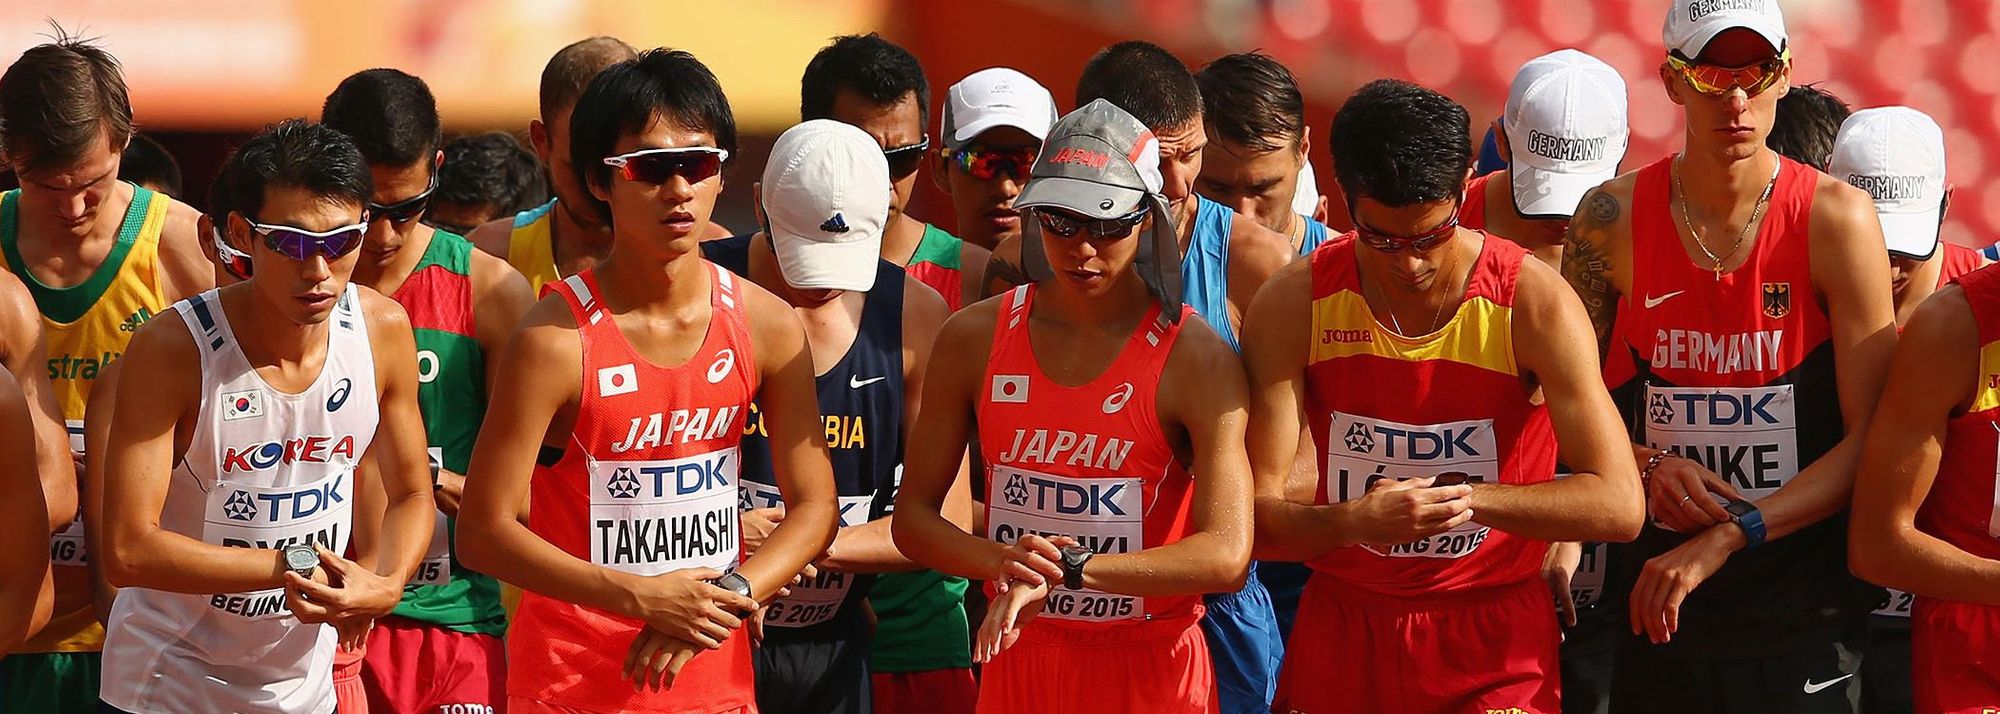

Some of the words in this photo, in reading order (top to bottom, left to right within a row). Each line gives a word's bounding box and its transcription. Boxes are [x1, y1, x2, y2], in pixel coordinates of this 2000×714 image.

[1050, 147, 1110, 168] JAPAN
[1528, 130, 1606, 161] GERMANY
[1848, 174, 1924, 199] GERMANY
[1652, 329, 1782, 374] GERMANY
[1673, 393, 1779, 425] TDK
[611, 405, 739, 453] JAPAN
[1374, 426, 1480, 460] TDK
[223, 435, 356, 473] KOREA
[1000, 429, 1135, 471] JAPAN
[1652, 443, 1781, 489] NKE
[640, 455, 728, 497] TDK
[258, 474, 343, 521] TDK
[1029, 477, 1126, 516] TDK
[597, 506, 733, 565] TAKAHASHI
[1435, 528, 1488, 555] 2015
[417, 562, 441, 581] 15
[211, 593, 289, 617] BEIJIN
[784, 602, 838, 623] 2015
[1079, 597, 1135, 617] 2015
